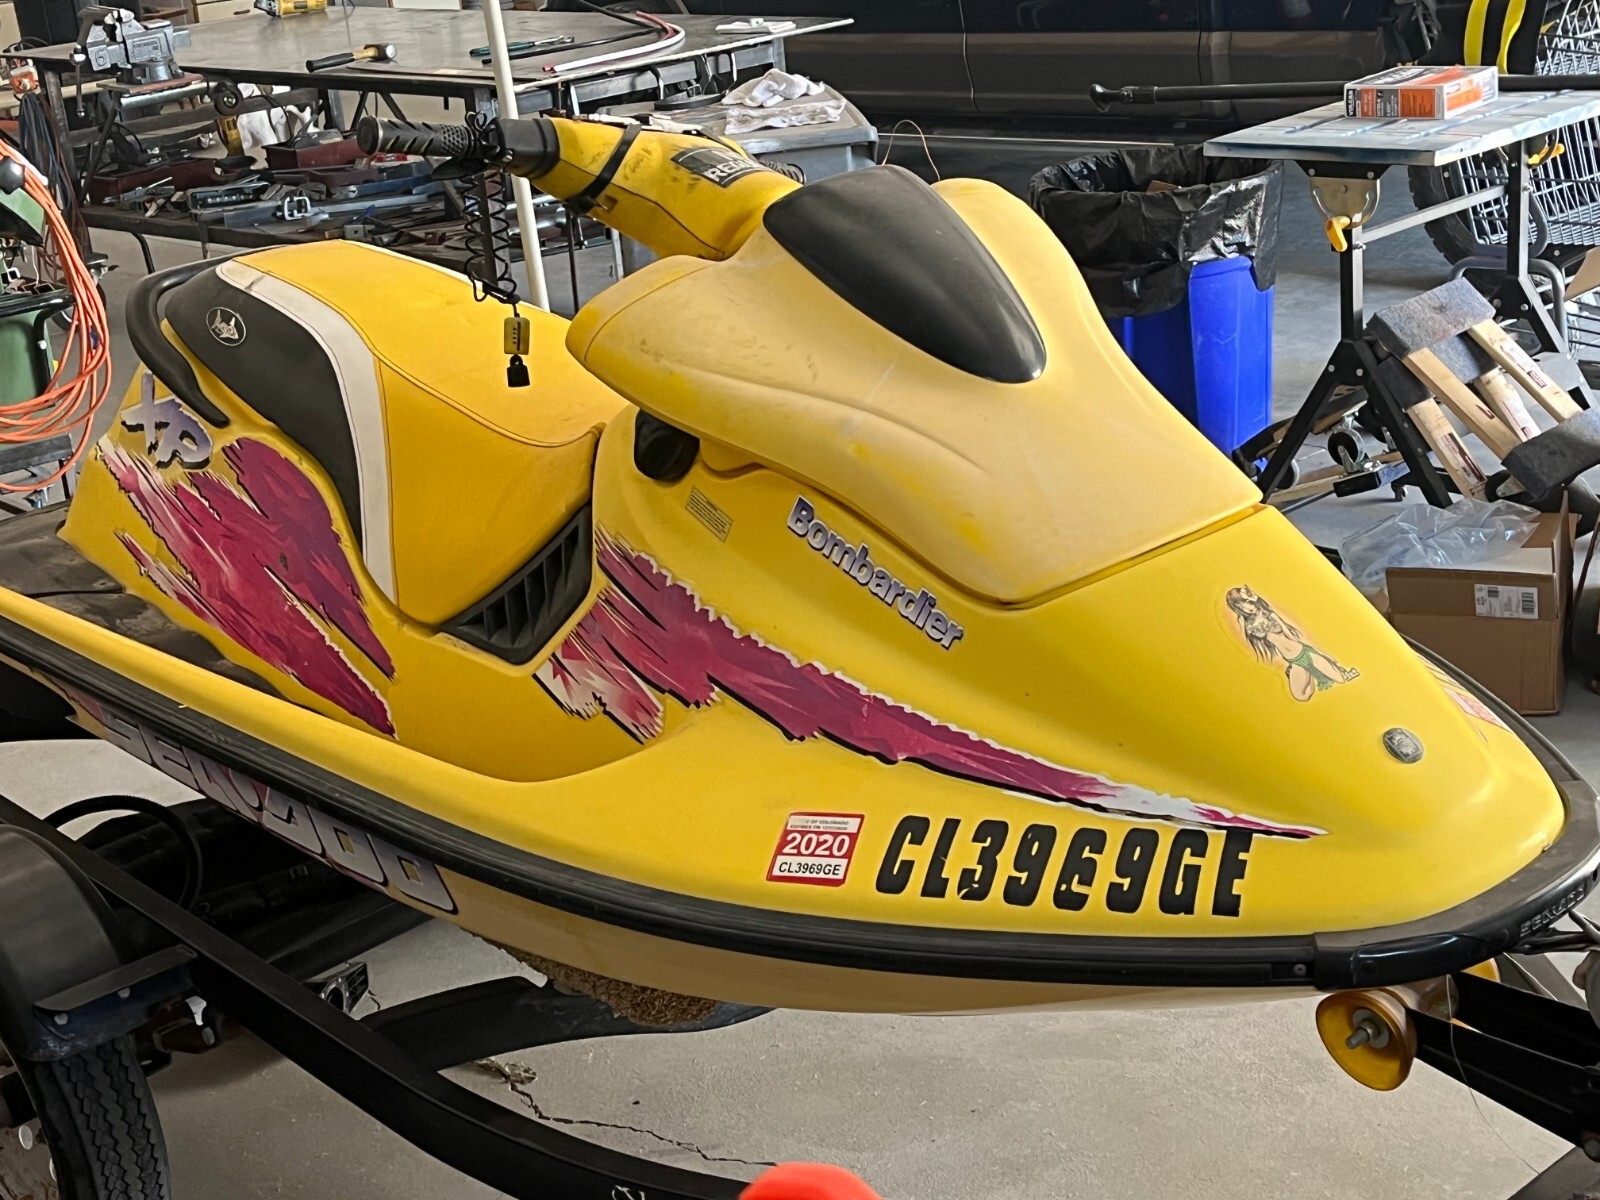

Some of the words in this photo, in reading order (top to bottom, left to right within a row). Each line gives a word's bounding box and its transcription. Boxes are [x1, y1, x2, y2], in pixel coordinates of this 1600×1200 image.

[95, 47, 108, 66] 6
[788, 495, 964, 650] Bombardier
[782, 832, 850, 857] 2020
[778, 861, 841, 876] CL3969GE
[875, 815, 1253, 917] CL3969GE
